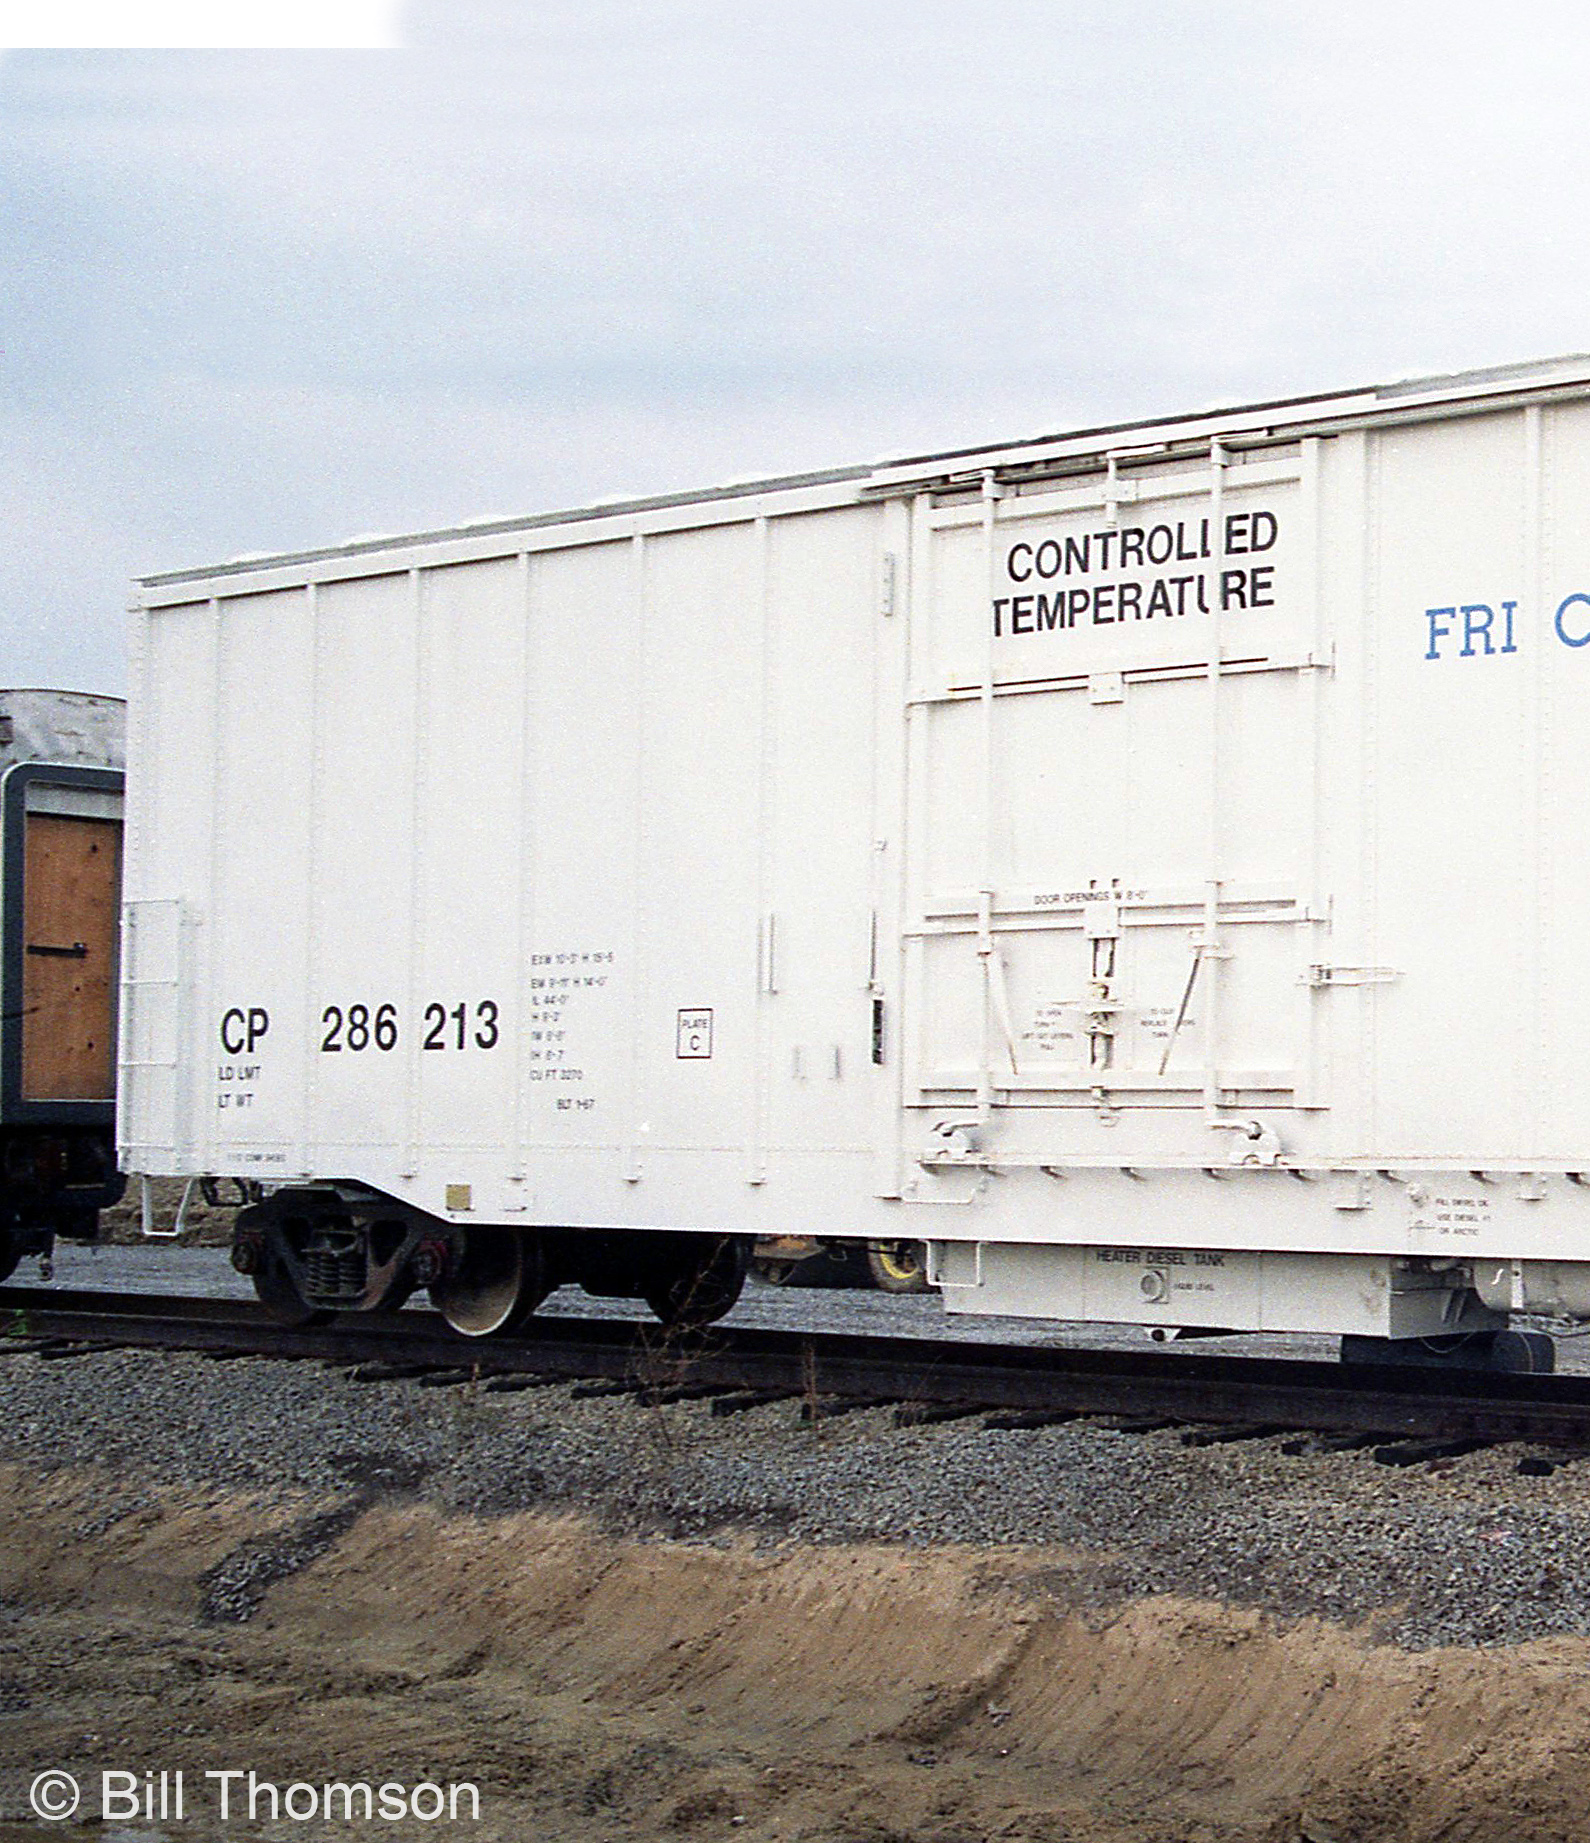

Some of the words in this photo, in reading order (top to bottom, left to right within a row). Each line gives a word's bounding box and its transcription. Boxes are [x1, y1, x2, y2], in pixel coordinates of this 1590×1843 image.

[1007, 510, 1279, 583] CONTROLLED
[1424, 600, 1518, 661] FRI
[220, 1007, 269, 1055] CP
[320, 1003, 398, 1052] 286
[423, 1000, 499, 1050] 213
[690, 1034, 701, 1051] C
[1096, 1249, 1141, 1264] HEATER
[1145, 1250, 1187, 1266] DIESEL
[1193, 1252, 1226, 1267] TANK
